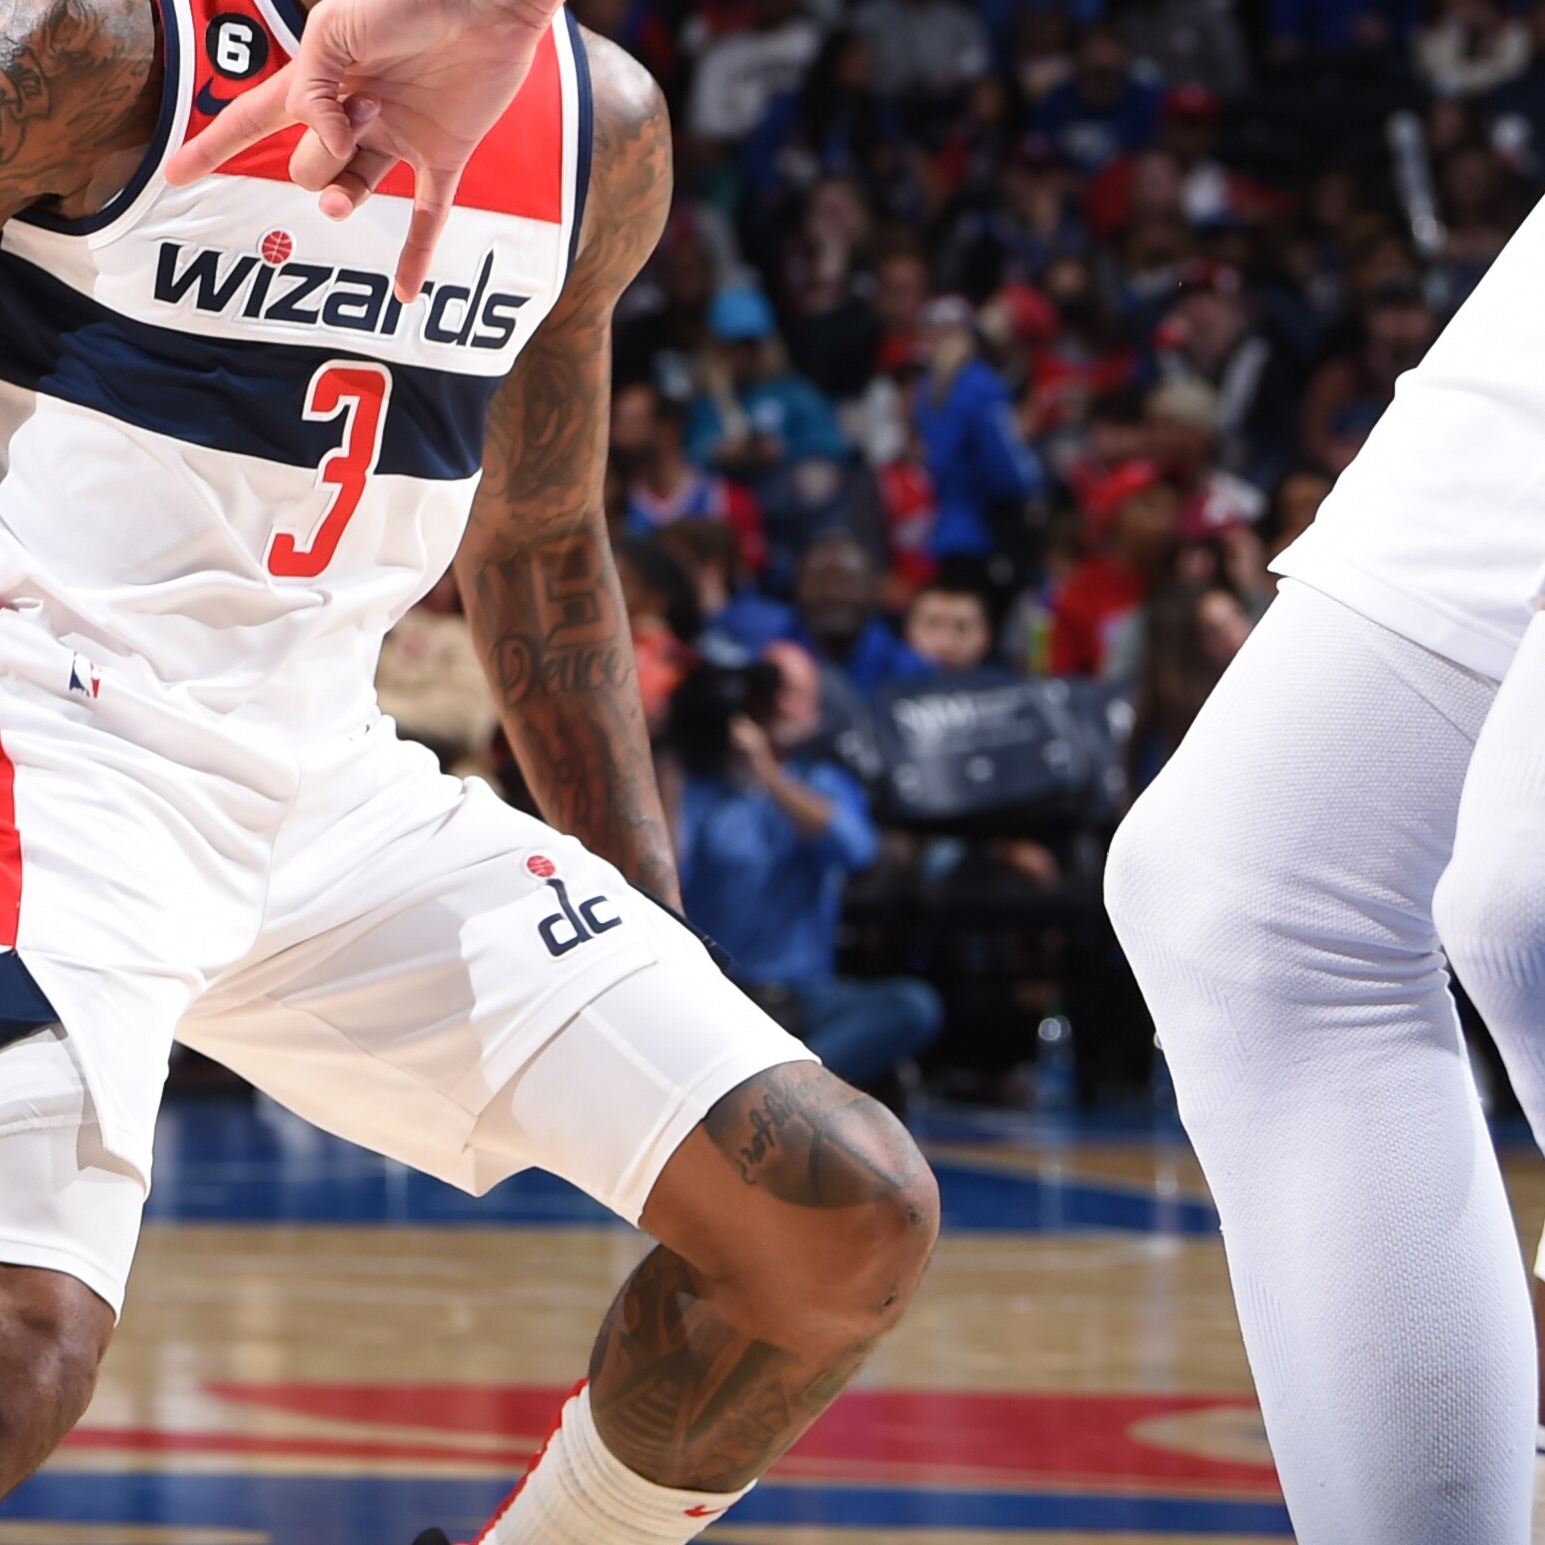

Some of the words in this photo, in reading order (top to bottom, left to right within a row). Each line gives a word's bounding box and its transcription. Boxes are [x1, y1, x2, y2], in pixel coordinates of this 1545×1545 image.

[217, 22, 252, 73] 6
[154, 230, 533, 351] wizards
[266, 362, 392, 579] 3
